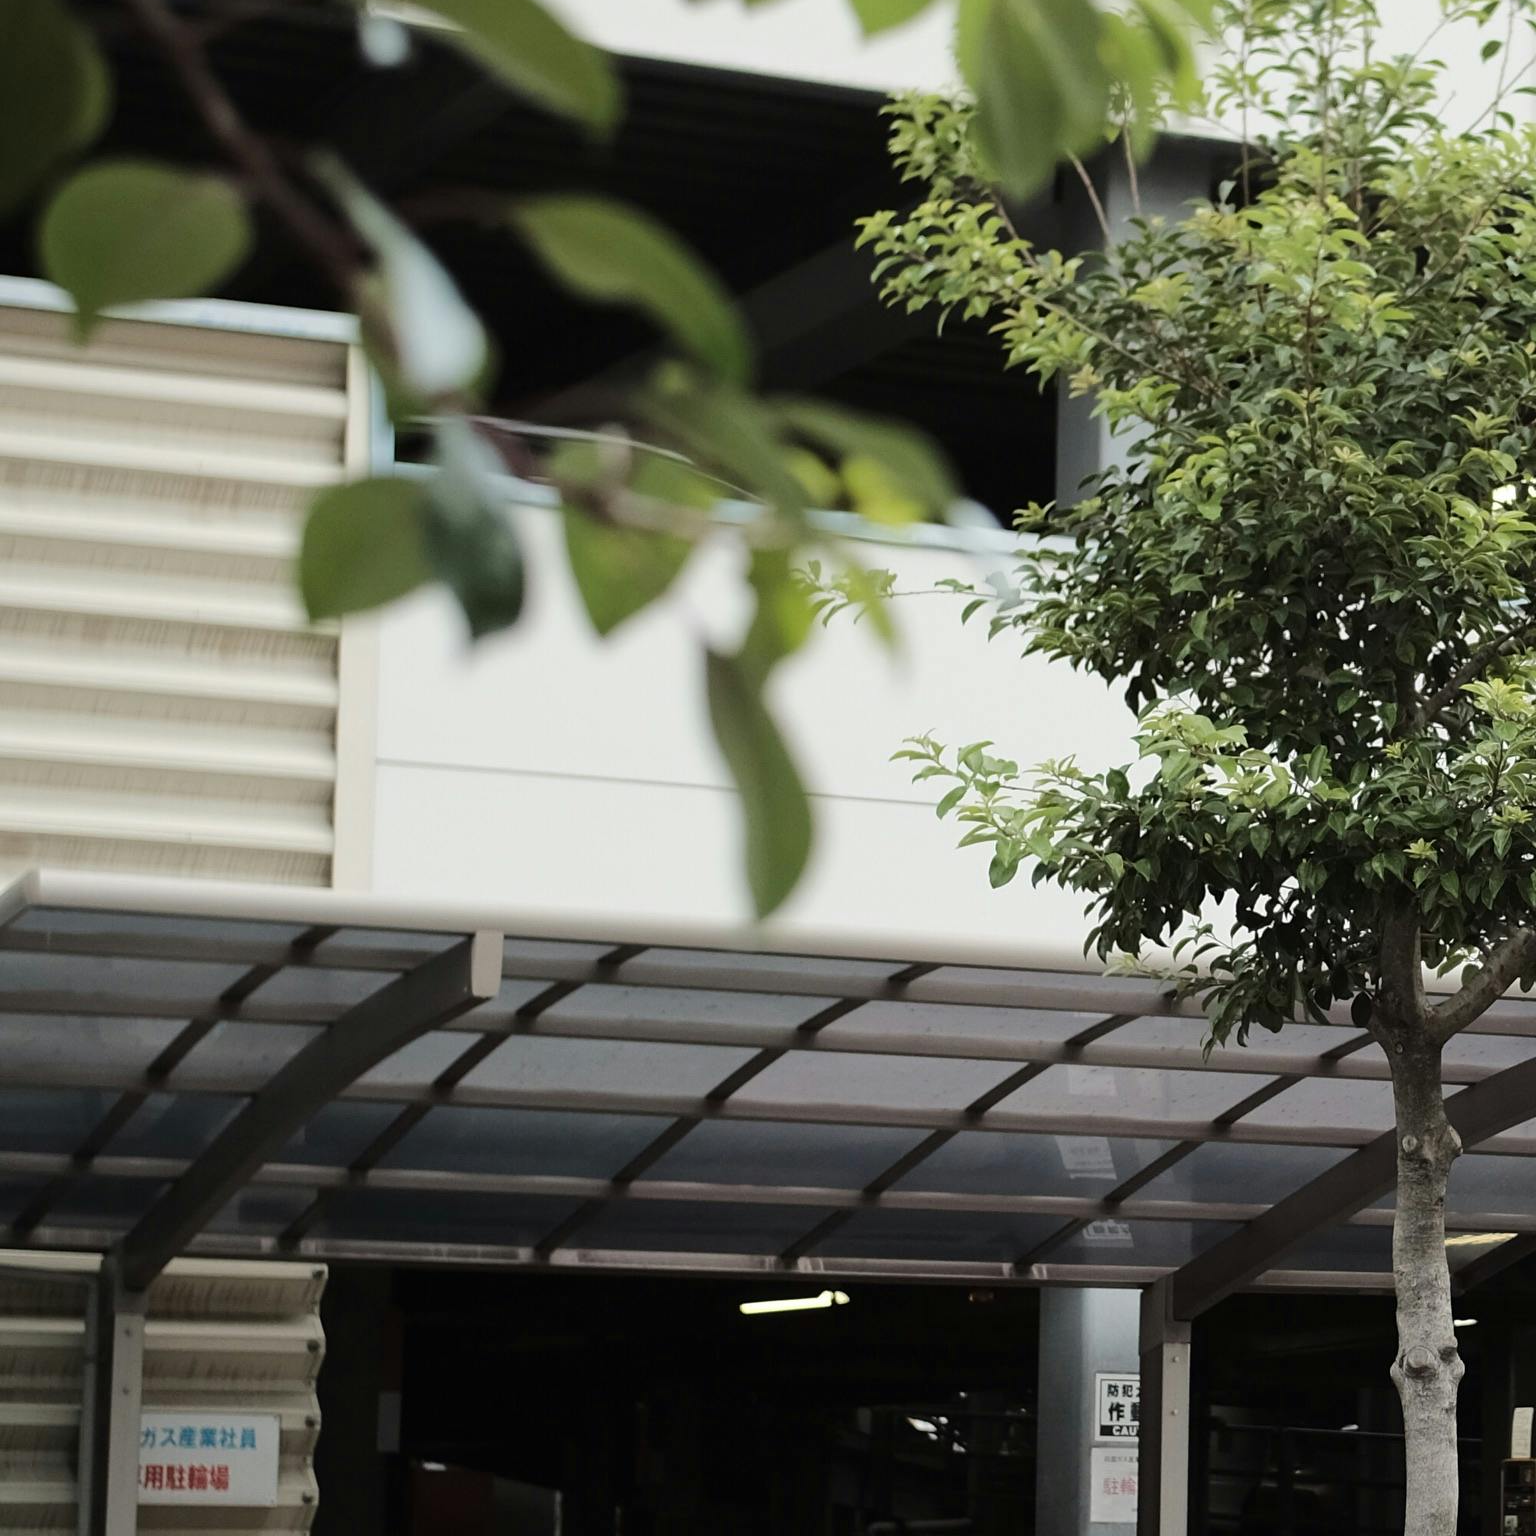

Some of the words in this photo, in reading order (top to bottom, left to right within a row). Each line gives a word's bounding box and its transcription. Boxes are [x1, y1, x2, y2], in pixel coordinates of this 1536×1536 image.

[1112, 1425, 1139, 1436] CAU
[138, 1464, 230, 1492] 用駐輪場
